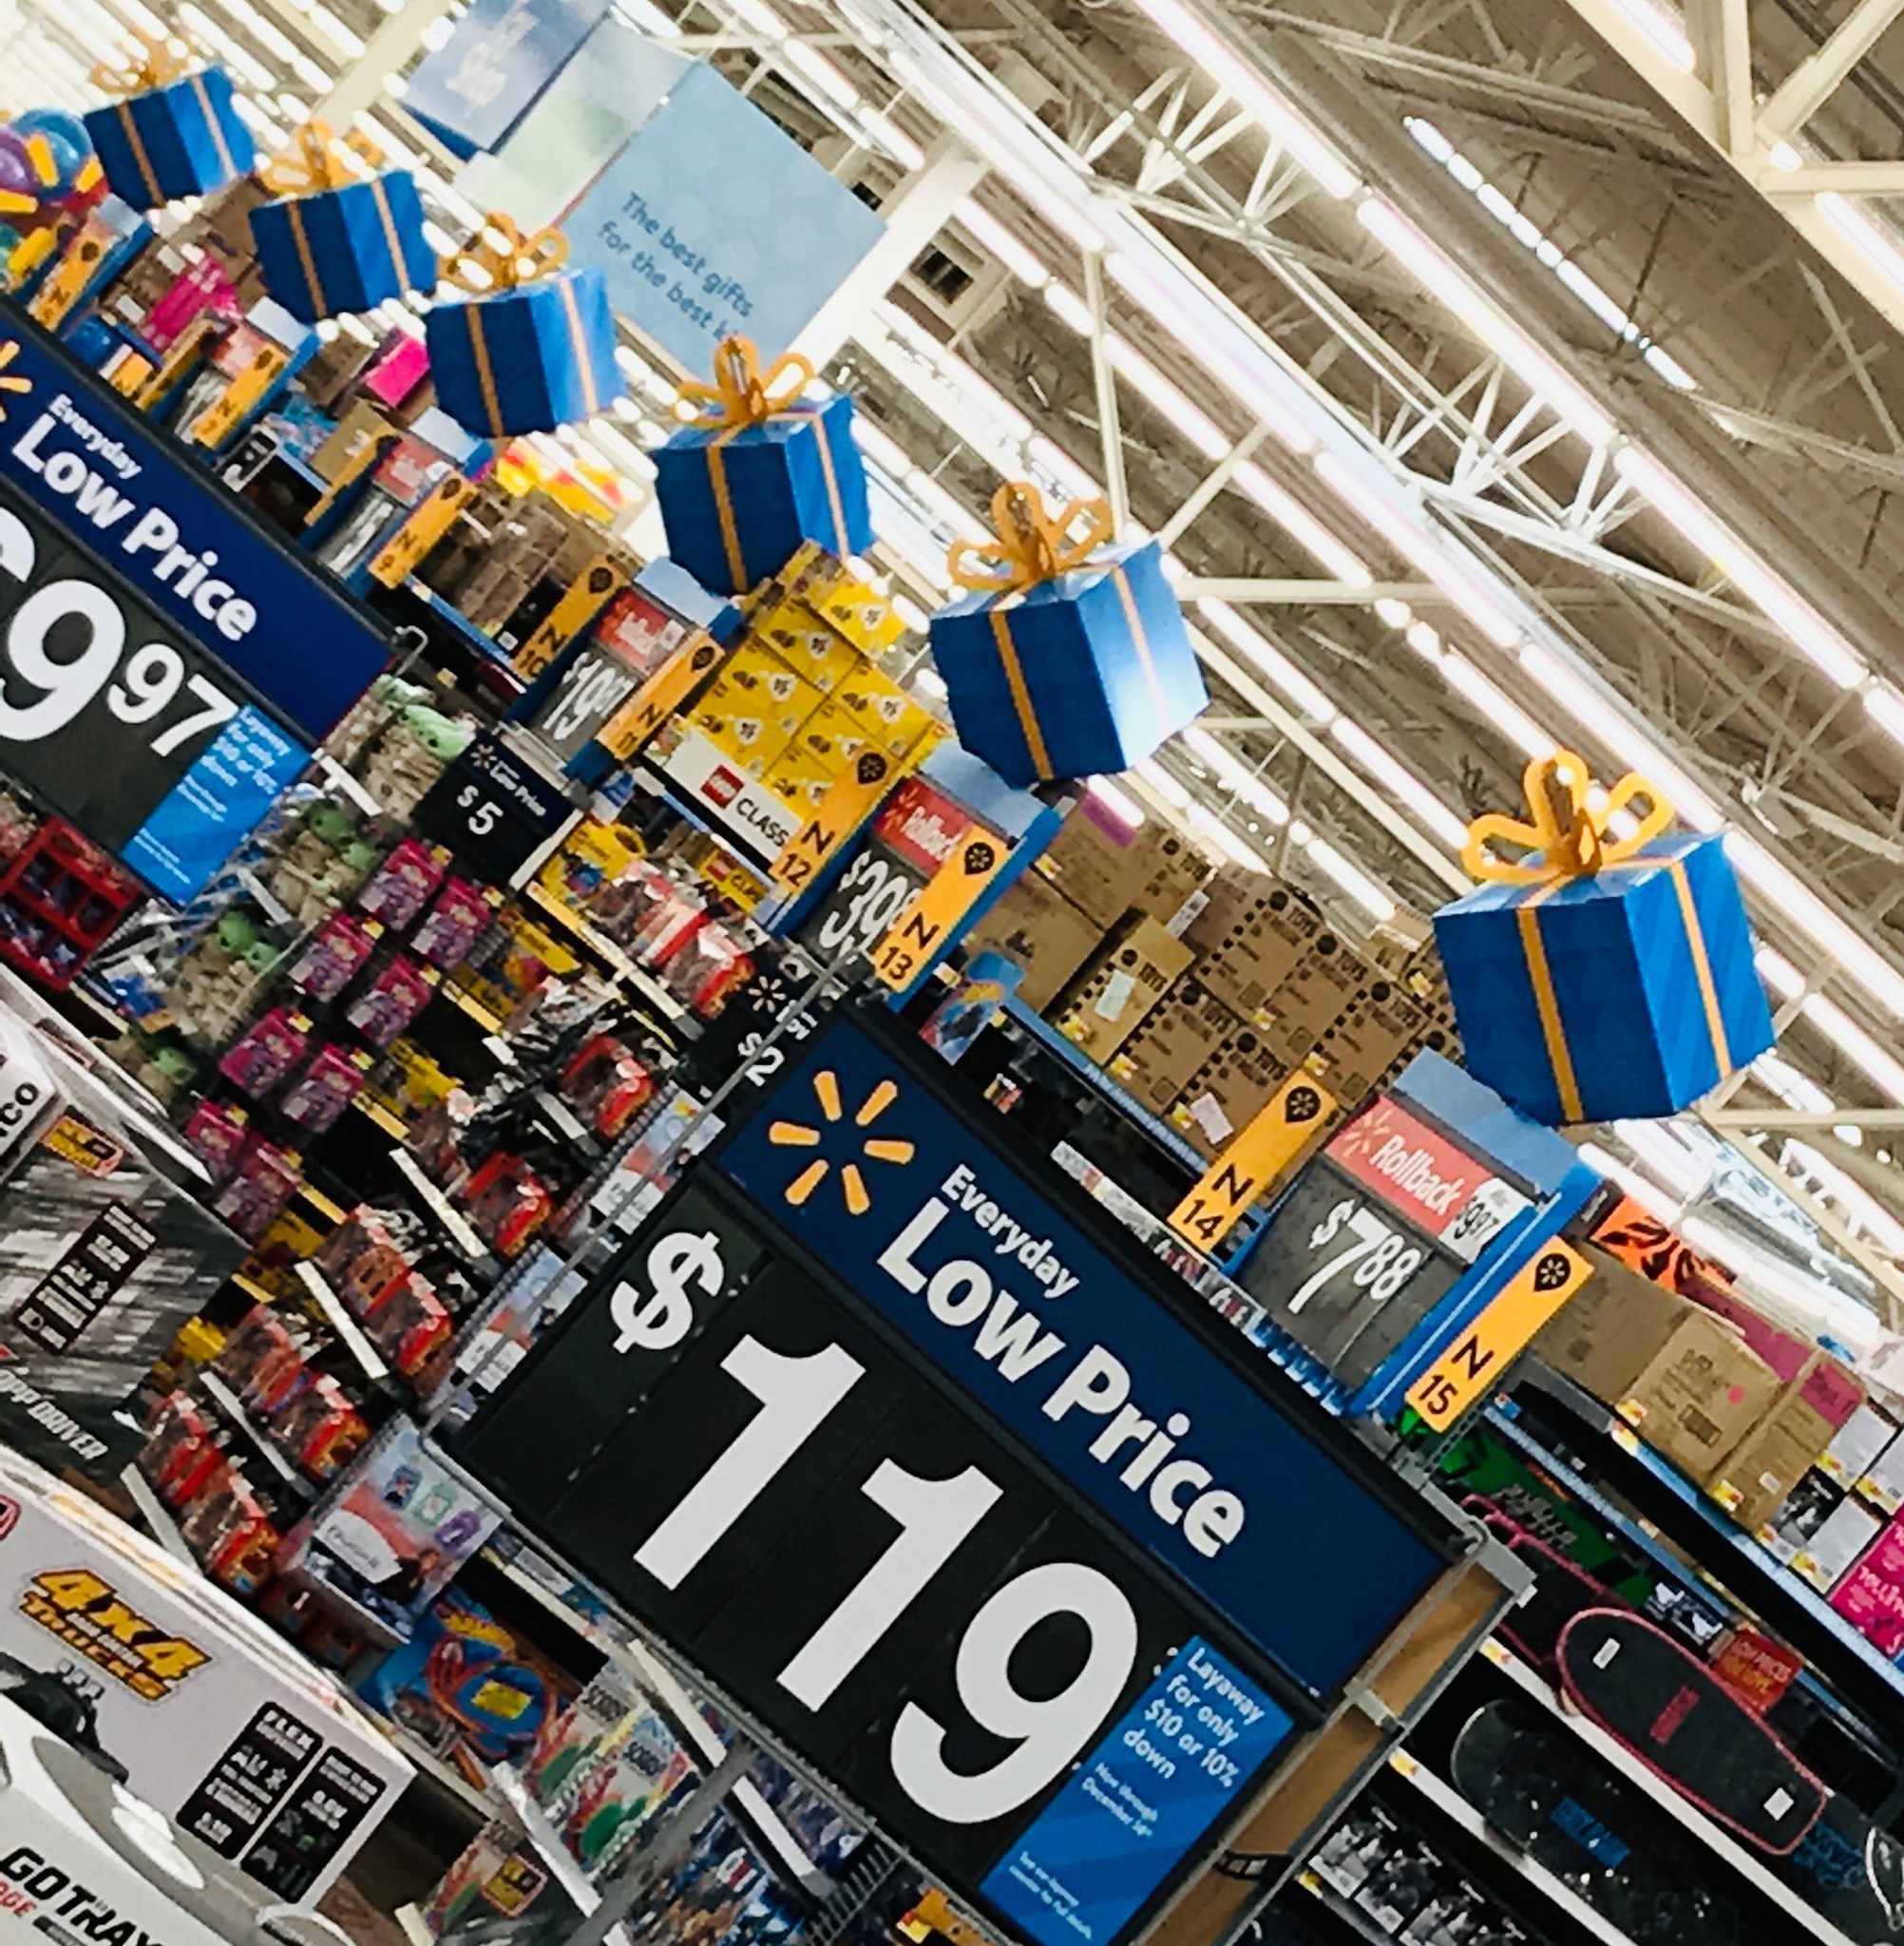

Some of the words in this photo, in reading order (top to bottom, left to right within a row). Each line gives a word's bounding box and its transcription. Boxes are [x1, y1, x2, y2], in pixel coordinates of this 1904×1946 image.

[598, 219, 631, 254] for
[631, 251, 666, 288] the
[666, 281, 713, 329] best
[622, 191, 660, 236] The
[659, 226, 707, 276] best
[701, 272, 753, 318] gifts
[48, 393, 143, 479] Everyday
[11, 413, 135, 529] Low
[122, 507, 258, 642] Price
[538, 623, 569, 654] N
[636, 701, 665, 730] N
[456, 785, 505, 836] $5
[800, 820, 836, 855] N
[778, 852, 813, 887] 12
[902, 910, 942, 951] N
[1285, 905, 1321, 940] TOYS
[880, 945, 915, 981] 13
[1338, 948, 1370, 983] TOYS
[1389, 999, 1423, 1030] TOYS
[1211, 1164, 1254, 1207] N
[1368, 1134, 1465, 1216] Rollback
[940, 1164, 1082, 1301] Everyday
[1182, 1198, 1225, 1241] 14
[1286, 1197, 1424, 1316] $788
[876, 1196, 1066, 1383] Low
[1040, 1343, 1246, 1559] Price
[1450, 1335, 1495, 1381] N
[1417, 1373, 1459, 1418] 15
[27, 1401, 109, 1460] DRIVER
[1166, 1673, 1200, 1708] for
[1197, 1707, 1240, 1747] only
[1187, 1647, 1266, 1727] Layaway
[1122, 1727, 1177, 1780] down
[1144, 1698, 1184, 1737] $10
[1177, 1733, 1205, 1756] or
[1198, 1747, 1241, 1789] 10%
